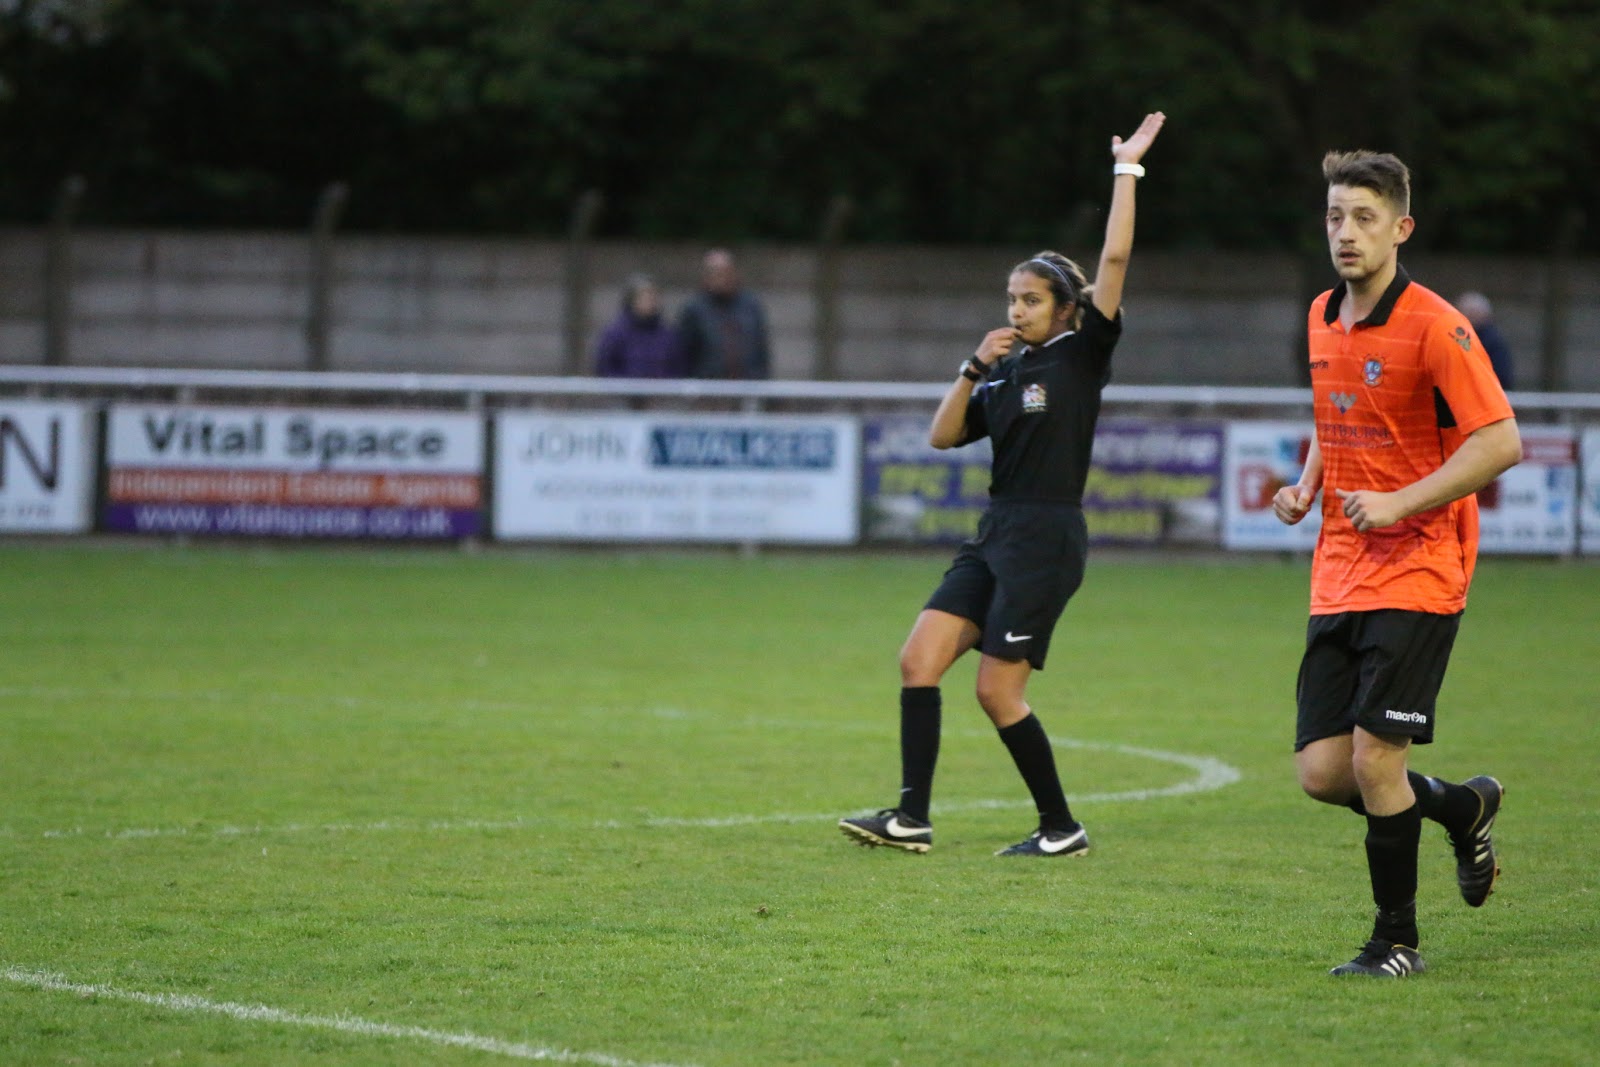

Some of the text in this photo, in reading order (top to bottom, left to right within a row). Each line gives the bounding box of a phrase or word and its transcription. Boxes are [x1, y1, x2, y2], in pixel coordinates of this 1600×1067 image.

[142, 412, 446, 471] Vital Space
[520, 426, 630, 462] JOHN
[660, 429, 834, 465] WALKER
[112, 472, 475, 505] Independent Estate Agents
[134, 507, 453, 536] www.vitalspace.co.uk
[1385, 709, 1427, 724] macron
